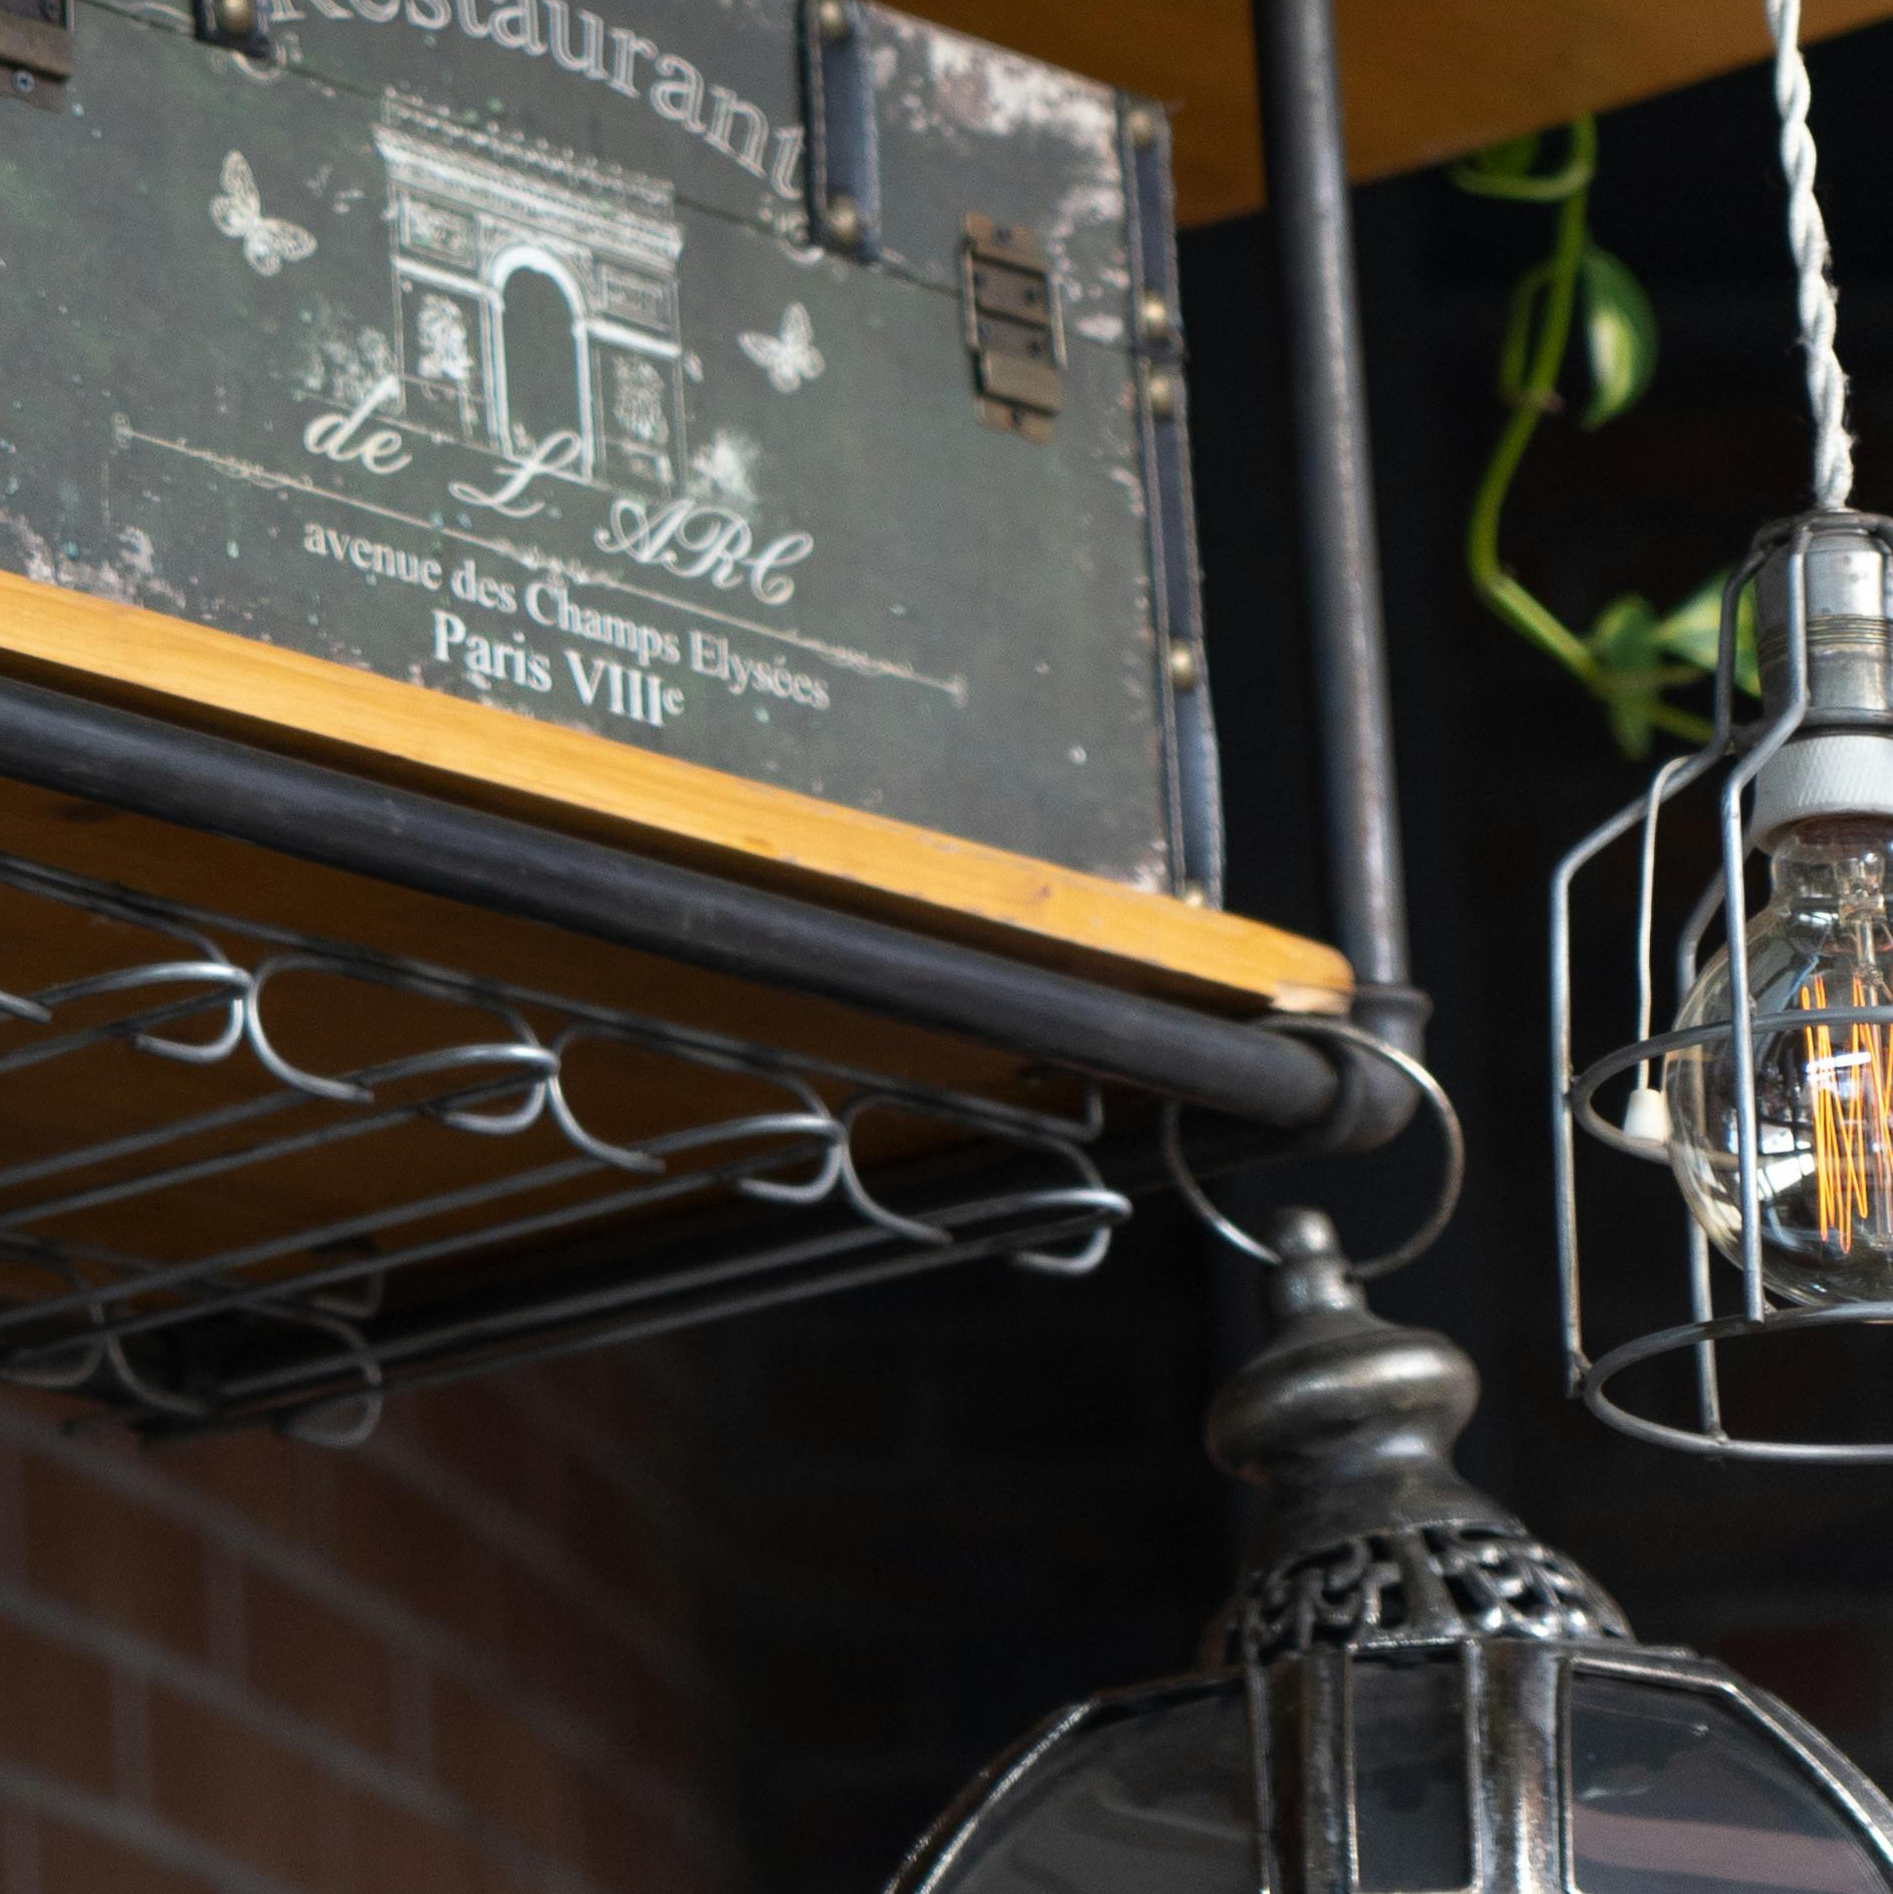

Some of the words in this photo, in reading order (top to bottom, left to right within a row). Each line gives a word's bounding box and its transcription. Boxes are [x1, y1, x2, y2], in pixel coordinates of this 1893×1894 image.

[305, 374, 412, 474] de
[595, 499, 814, 605] ARC
[305, 522, 443, 591] avenue
[451, 560, 517, 613] des
[526, 580, 682, 666] Champs
[433, 610, 553, 692] Paris
